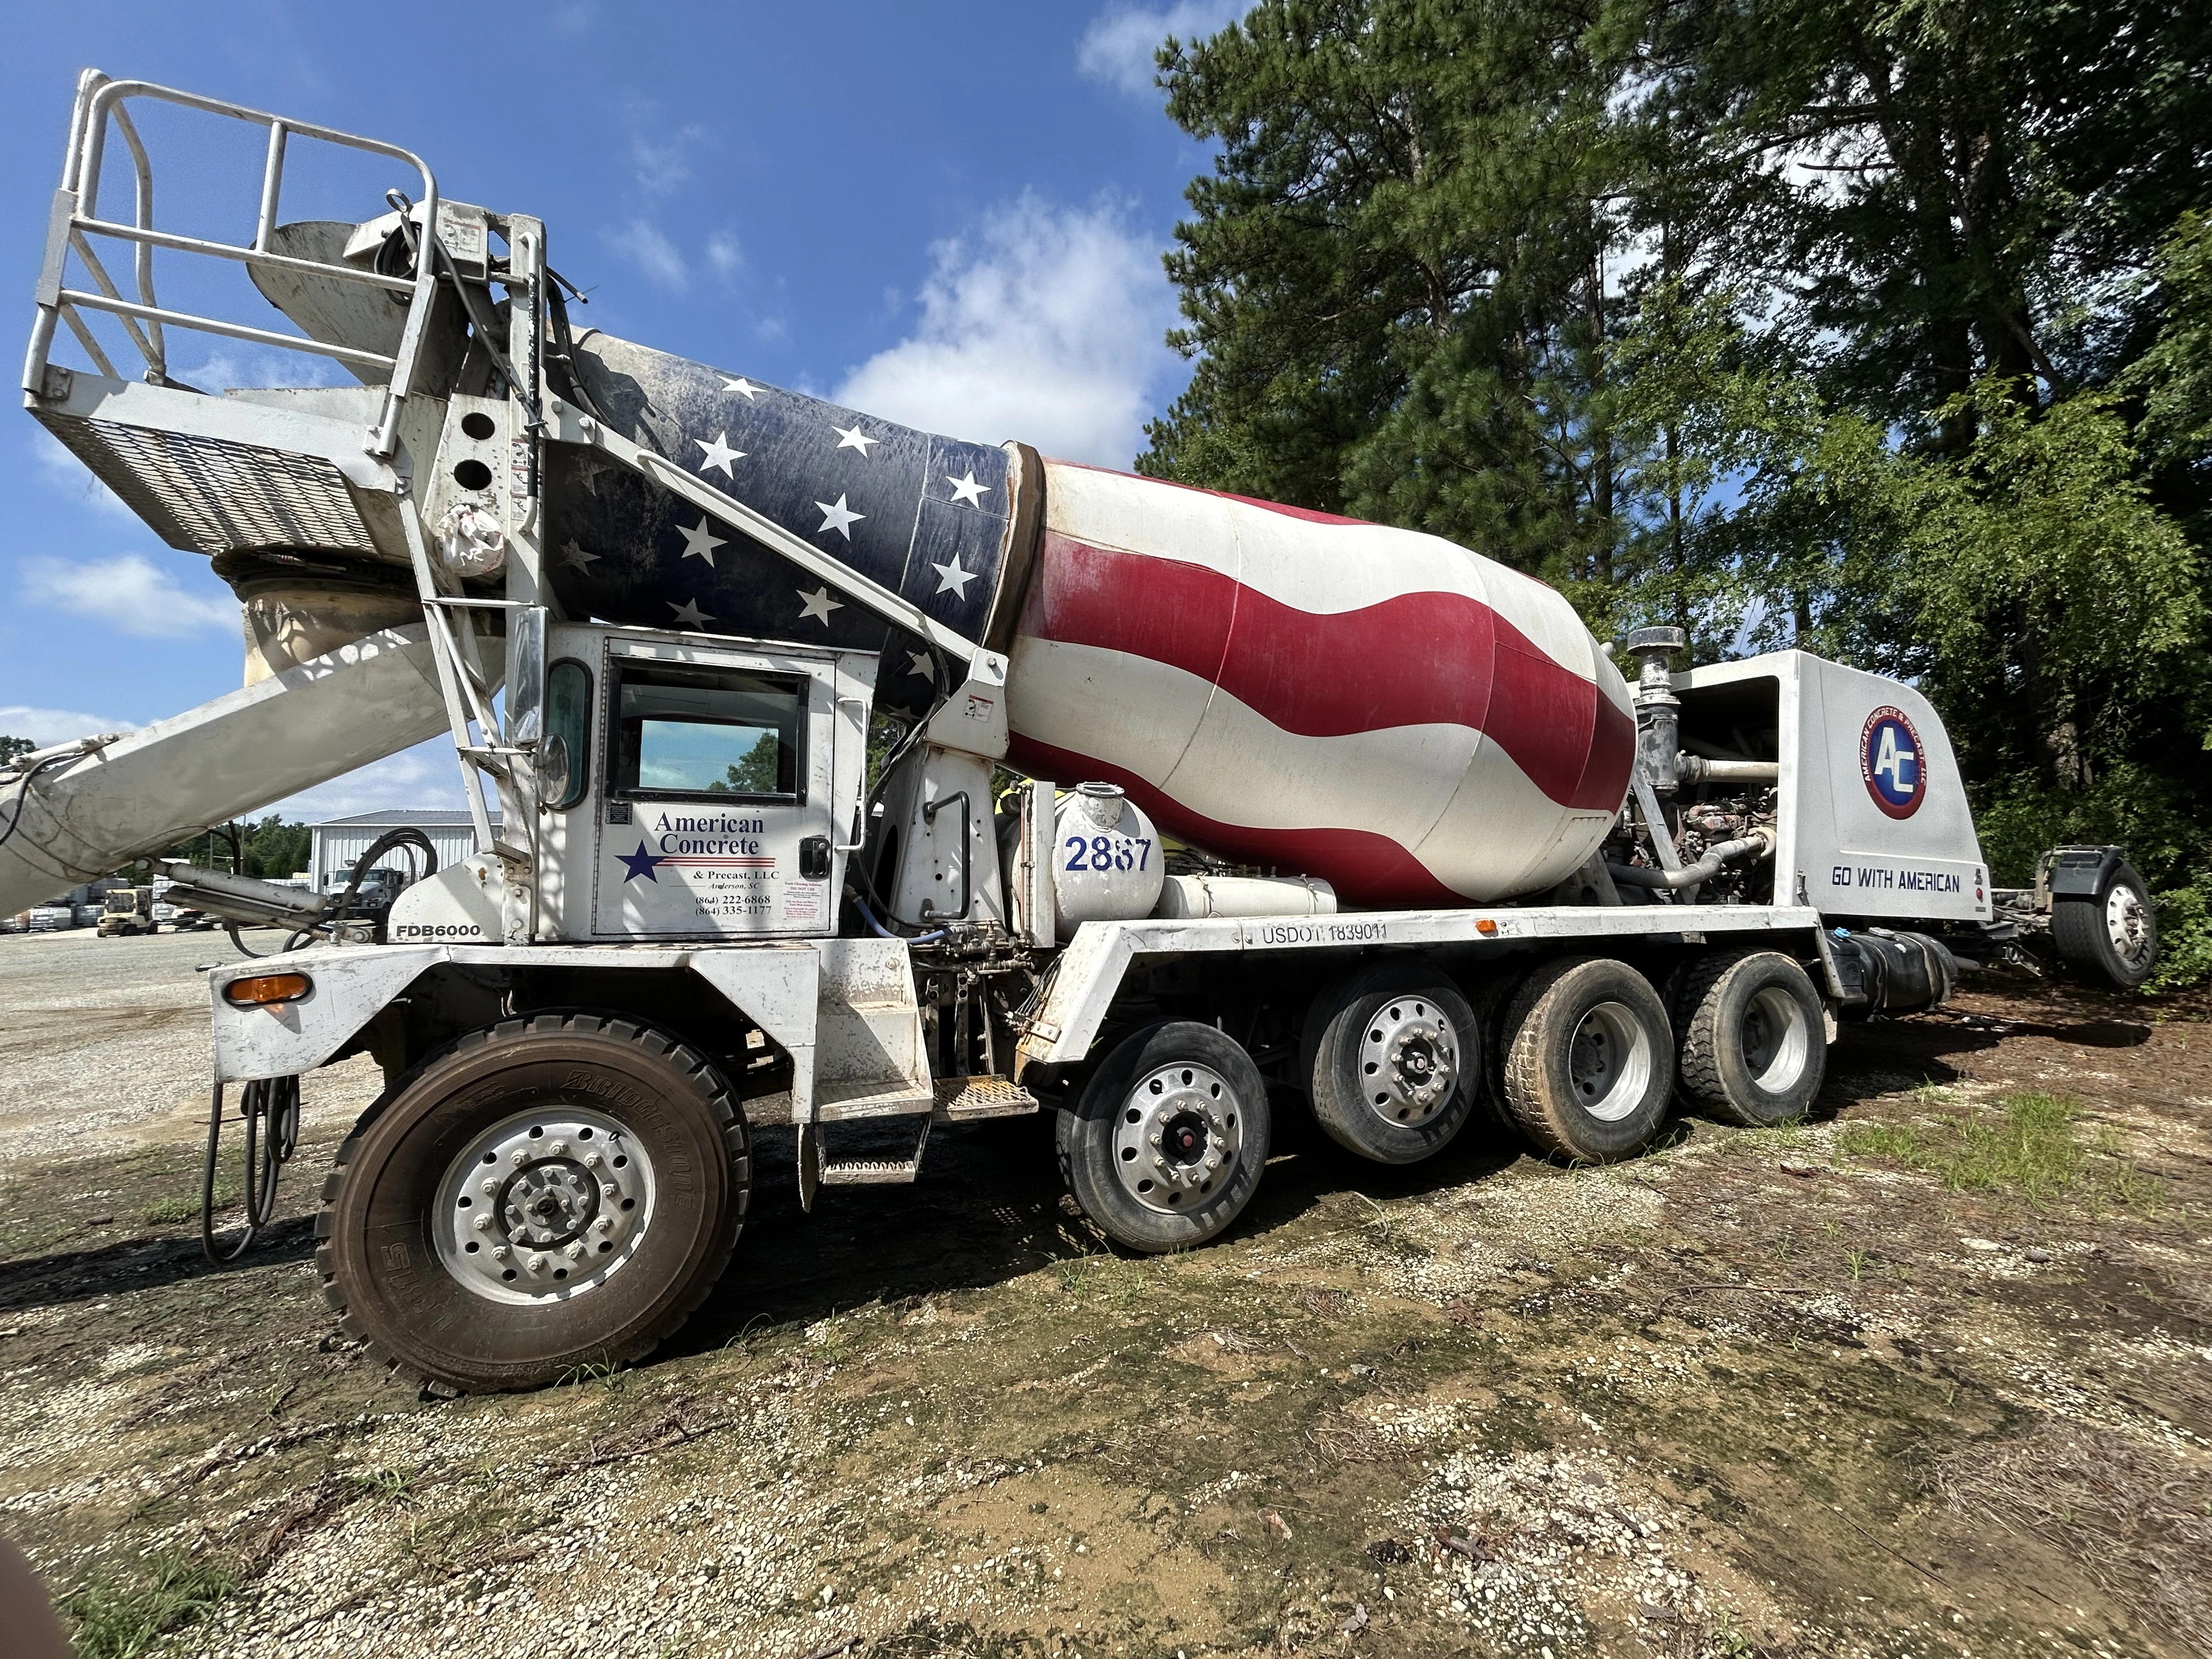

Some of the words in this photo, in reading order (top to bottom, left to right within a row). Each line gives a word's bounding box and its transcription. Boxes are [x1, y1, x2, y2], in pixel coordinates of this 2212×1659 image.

[1860, 727, 1872, 782] AMERICAN
[1866, 707, 1898, 729] CONCRETE
[1874, 726, 1915, 793] AC
[654, 811, 764, 833] American
[659, 833, 759, 855] Concrete
[693, 870, 704, 879] &
[708, 871, 751, 881] Precast,
[754, 871, 780, 879] LLC
[1832, 866, 1852, 886] GO
[1857, 867, 1893, 888] WITH
[1898, 870, 1960, 893] AMERICAN
[695, 896, 719, 905] (864)
[722, 895, 771, 905] 222-6868
[695, 907, 720, 916] (864)
[722, 905, 772, 915] 335-1177
[396, 924, 481, 937] FDB6000
